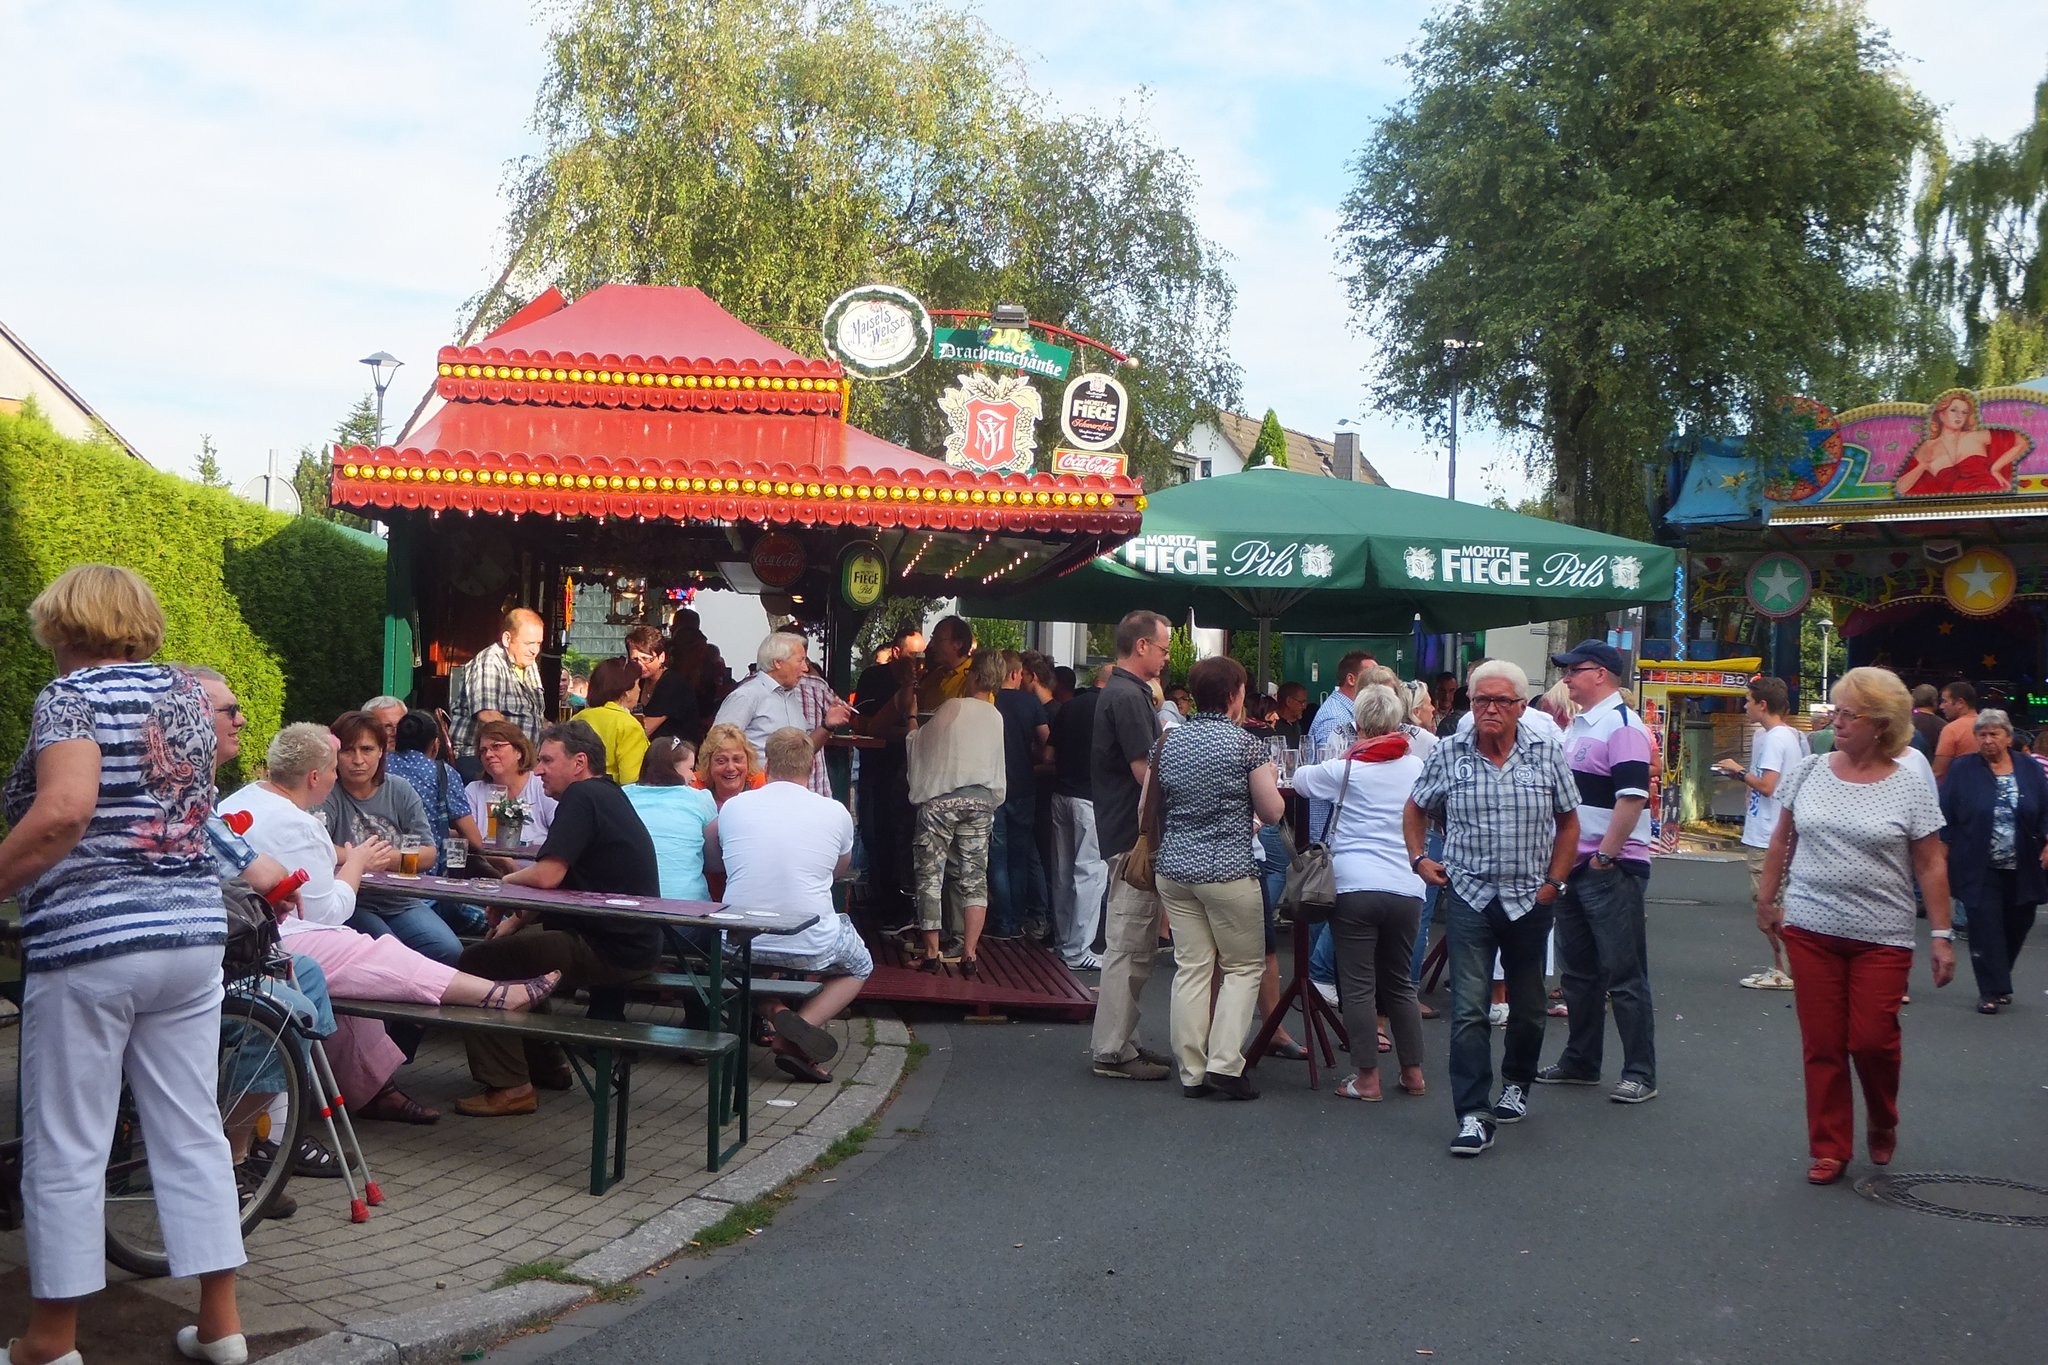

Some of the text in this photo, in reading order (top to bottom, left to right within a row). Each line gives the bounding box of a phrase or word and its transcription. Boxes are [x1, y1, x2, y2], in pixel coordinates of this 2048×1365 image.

[938, 342, 1063, 377] Drachenschänke
[1071, 399, 1117, 421] FIEGE
[1145, 534, 1197, 547] MORITZ
[1461, 545, 1510, 558] MORITZ
[1126, 536, 1299, 577] FIEGE Pils
[1441, 548, 1608, 588] FIEGE Pils
[854, 571, 879, 585] FIEGE
[1454, 755, 1473, 780] 6
